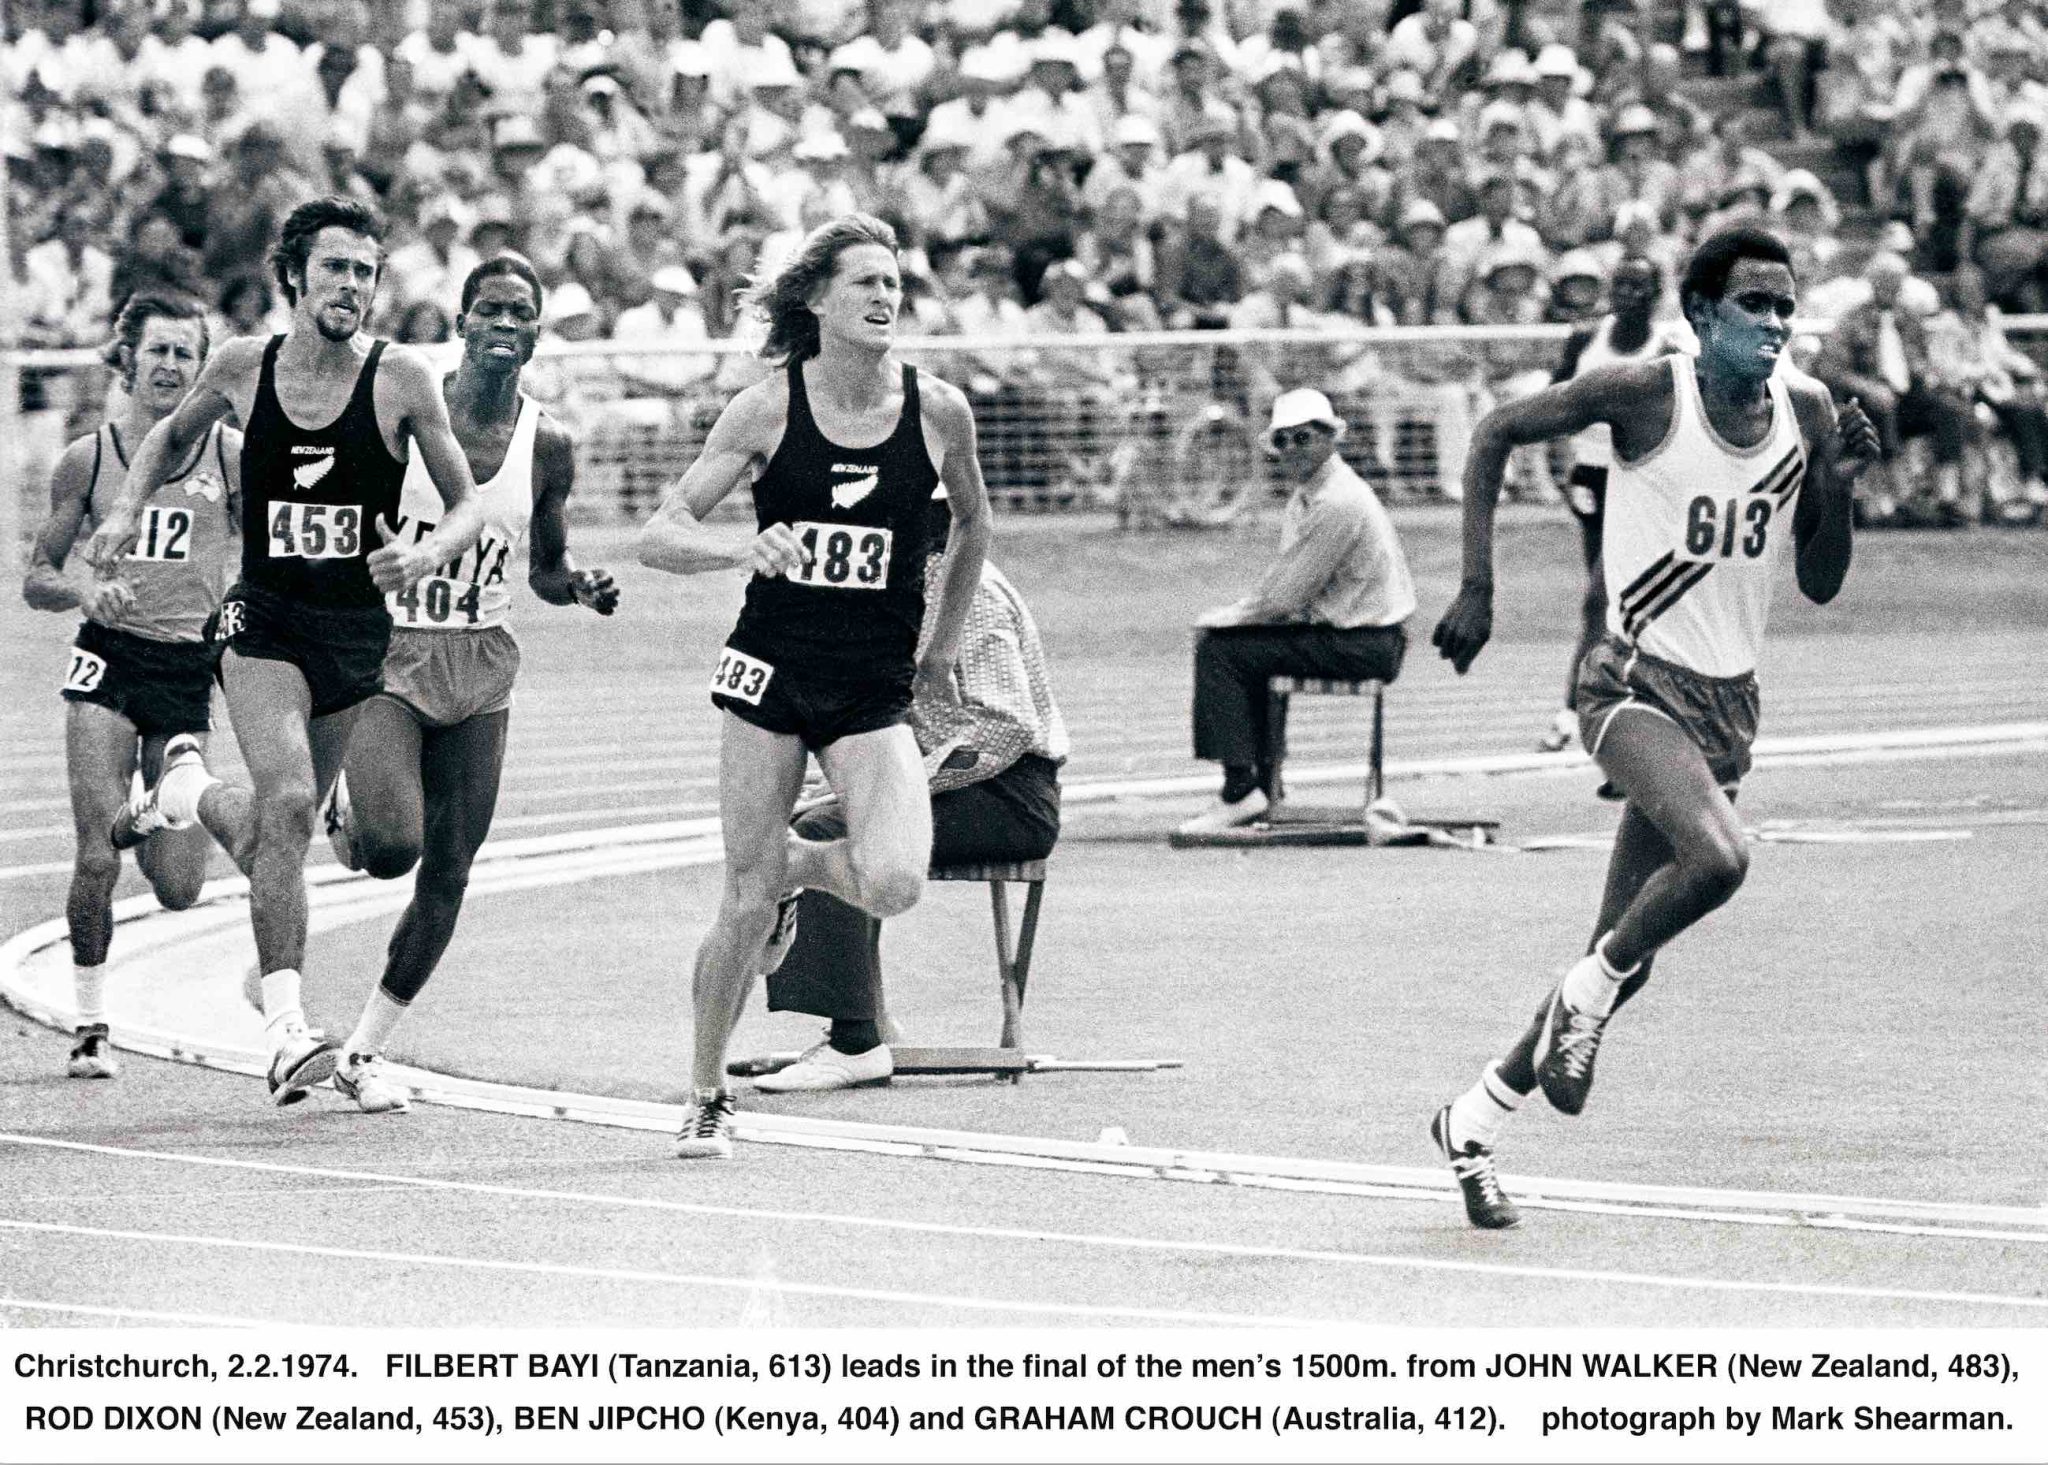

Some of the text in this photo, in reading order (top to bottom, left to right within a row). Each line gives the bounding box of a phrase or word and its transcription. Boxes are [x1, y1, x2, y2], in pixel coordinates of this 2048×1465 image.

[133, 509, 190, 560] 12
[271, 503, 359, 554] 453
[1686, 495, 1772, 559] 613
[800, 527, 886, 584] 483
[396, 580, 480, 624] 404
[715, 655, 767, 697] 483
